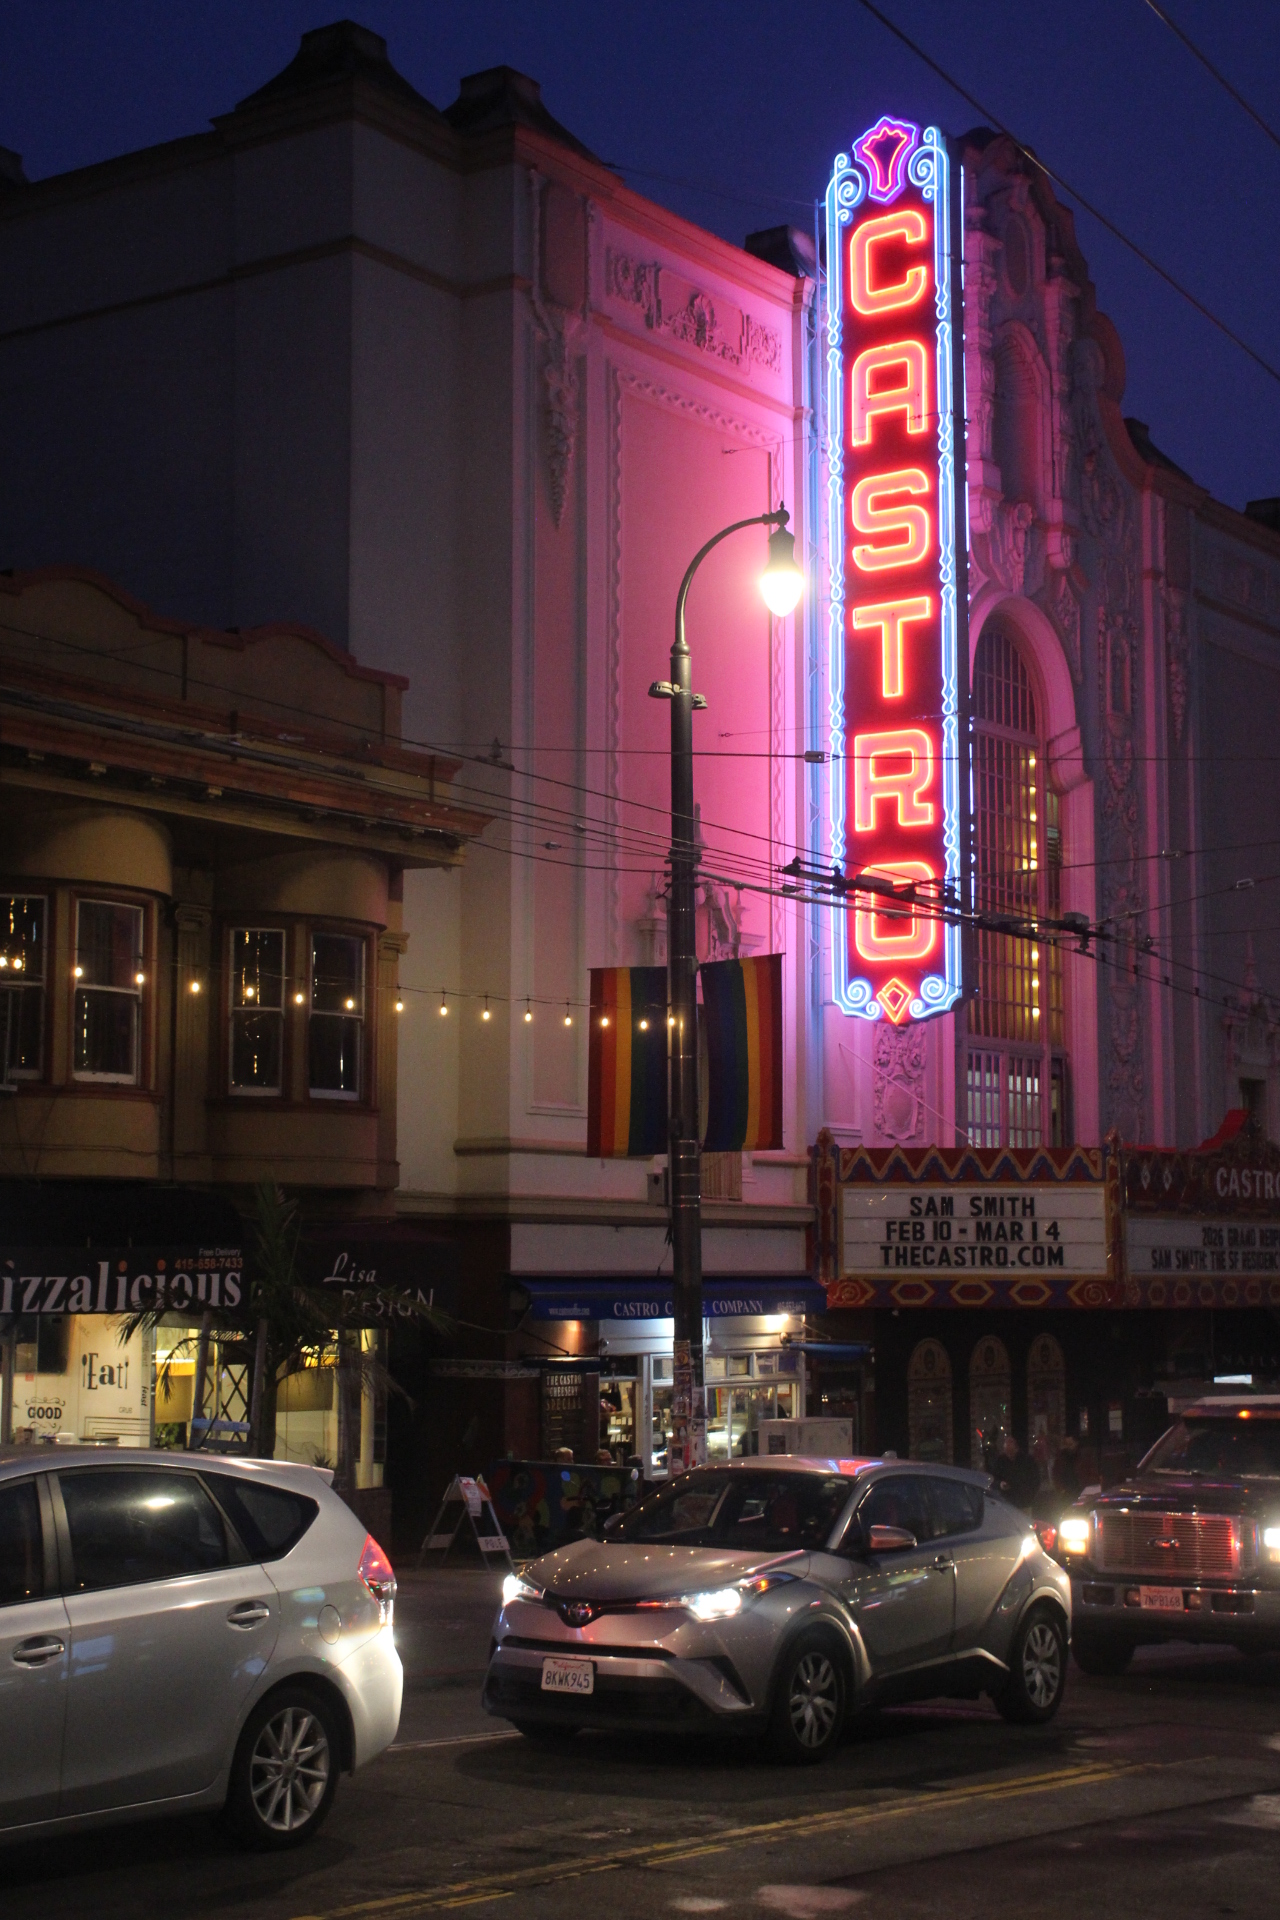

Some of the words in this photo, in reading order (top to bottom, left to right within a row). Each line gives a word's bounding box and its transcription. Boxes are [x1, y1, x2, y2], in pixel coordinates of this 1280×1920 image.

[848, 207, 936, 964] CASTRO
[910, 1196, 954, 1217] SAM
[969, 1196, 1036, 1217] SMITH
[886, 1220, 925, 1242] FEB
[933, 1220, 952, 1241] 10
[976, 1220, 1024, 1242] MAR
[215, 1248, 241, 1257] Delivery
[880, 1245, 1064, 1266] THECASTRO.COM
[1151, 1249, 1172, 1269] SAM
[1211, 1251, 1226, 1270] THE
[1228, 1251, 1239, 1270] SF
[322, 1252, 377, 1283] Lisa
[613, 1302, 660, 1316] CASTRO
[712, 1300, 763, 1314] COMPANY
[87, 1352, 124, 1390] Eat
[546, 1375, 559, 1386] THE
[560, 1374, 581, 1385] CASTRO
[27, 1406, 63, 1420] GOOD
[545, 1670, 590, 1689] 8KWK945
